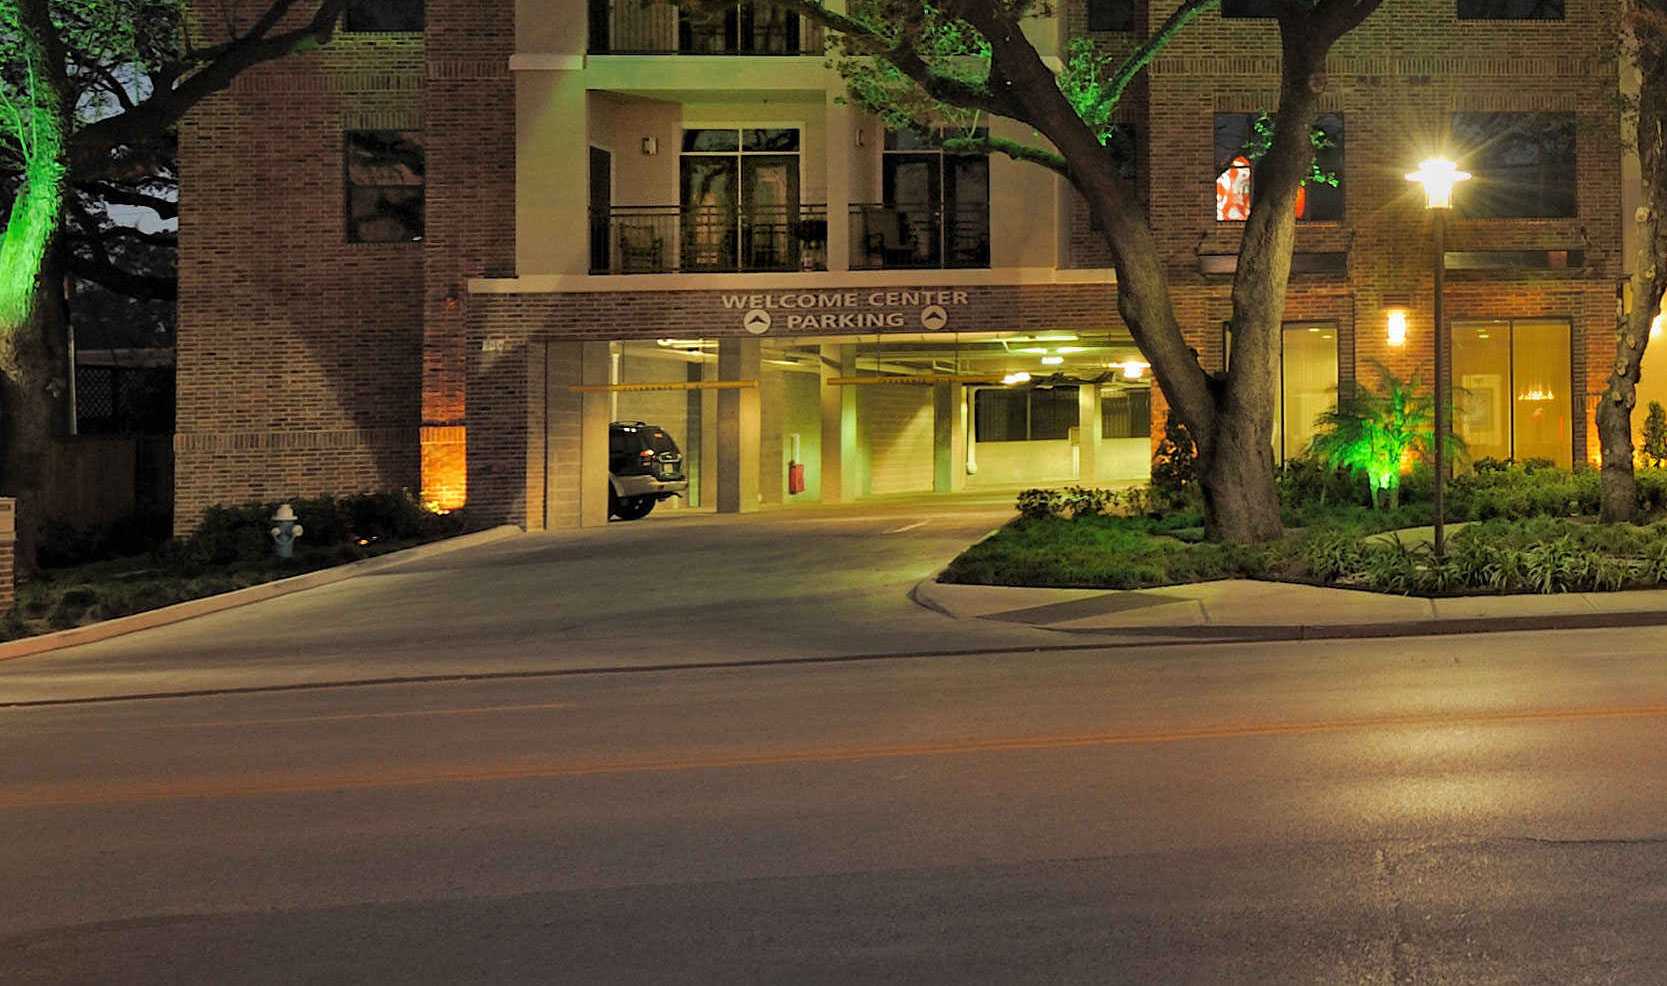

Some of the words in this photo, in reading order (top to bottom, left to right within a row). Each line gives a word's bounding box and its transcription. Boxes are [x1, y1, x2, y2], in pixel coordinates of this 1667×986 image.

[721, 292, 859, 310] WELCOME
[868, 290, 969, 307] CENTER
[787, 312, 905, 330] PARKING
